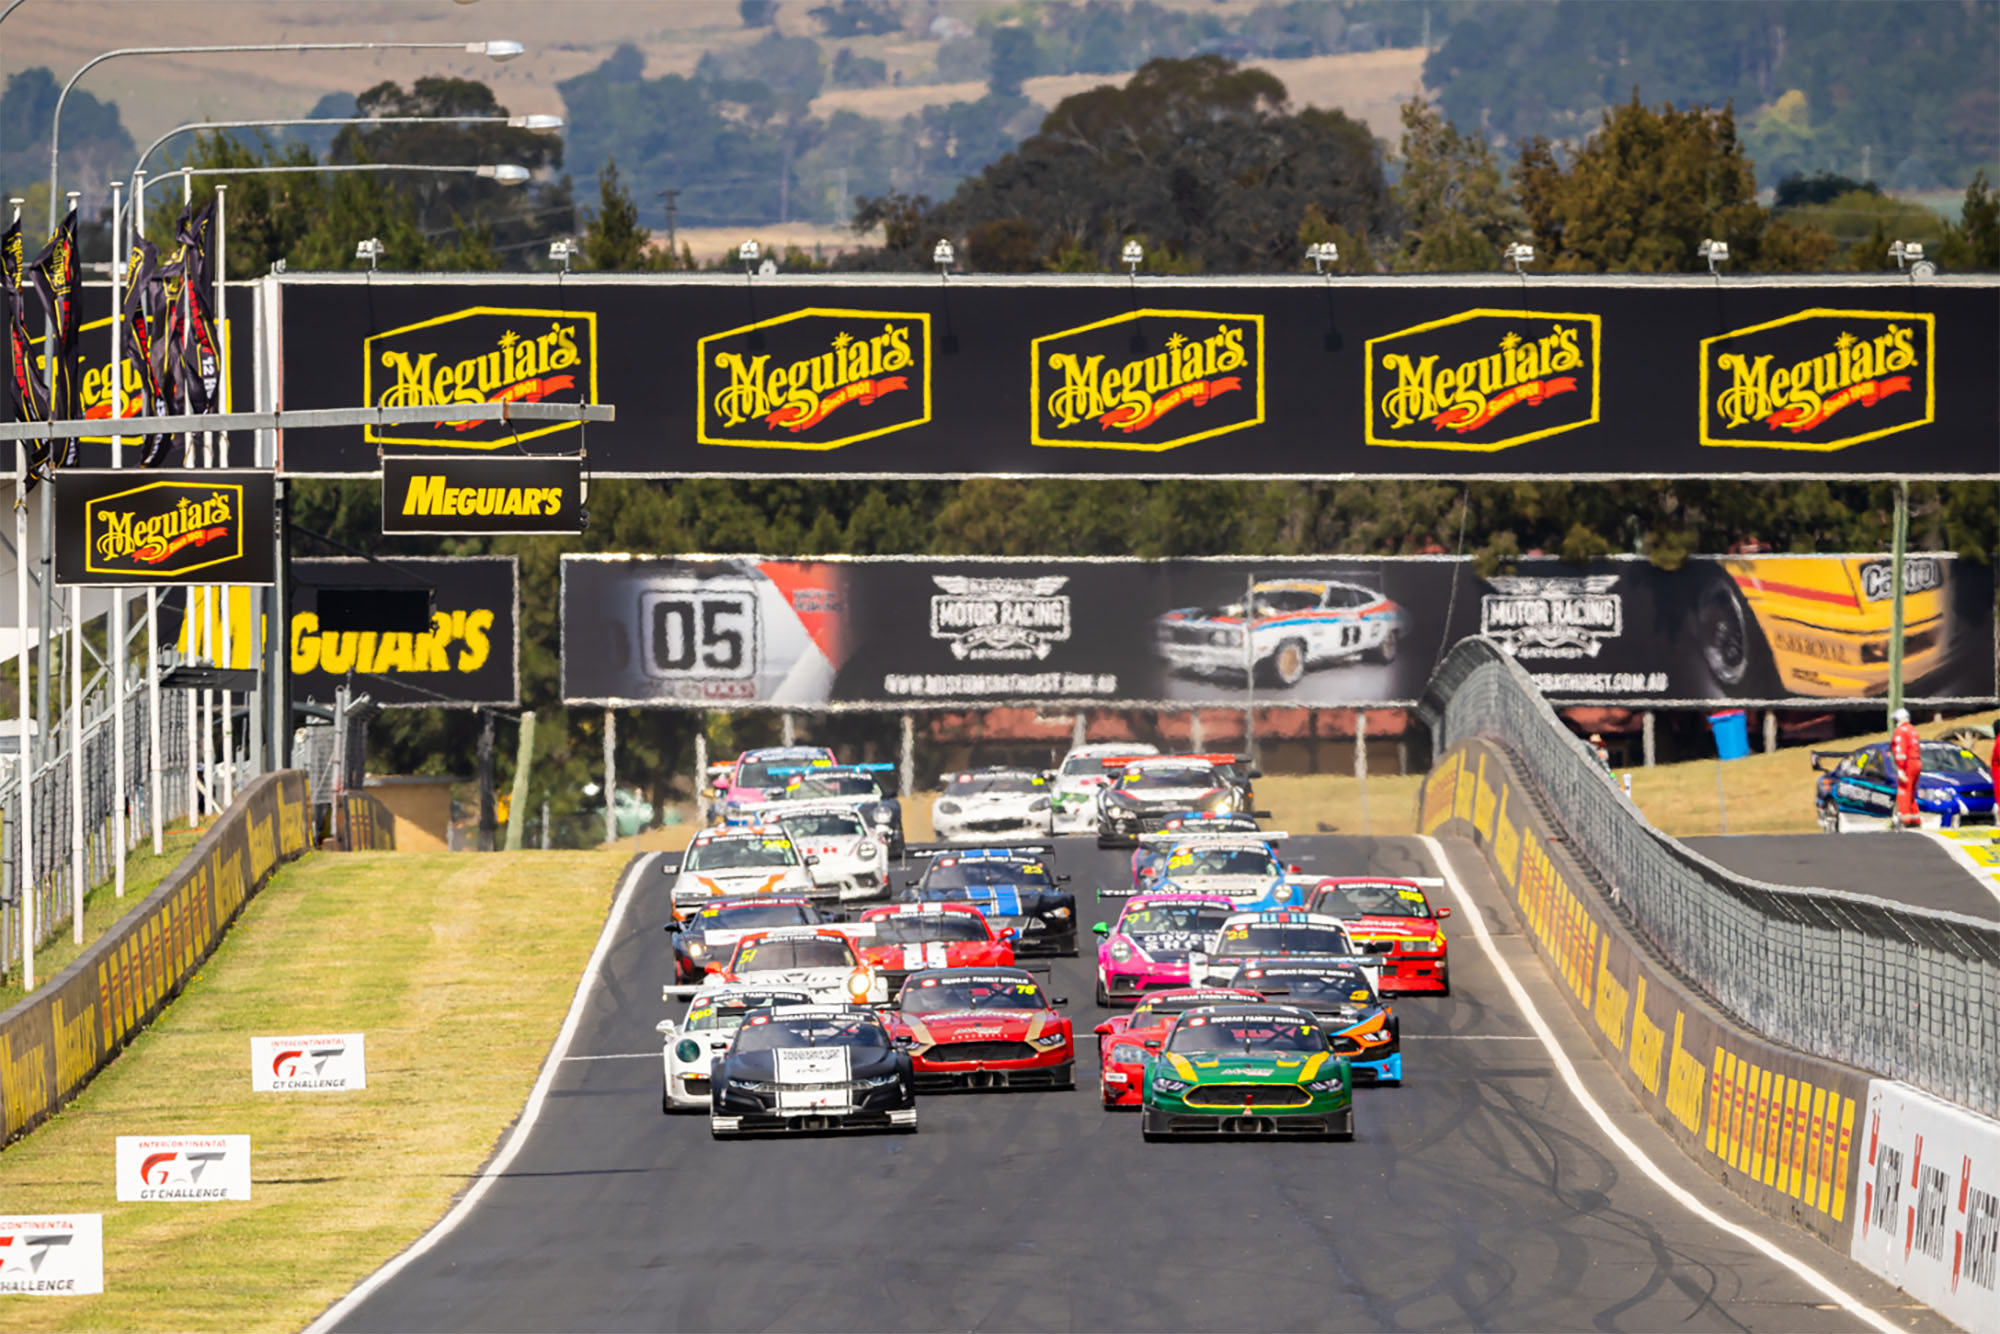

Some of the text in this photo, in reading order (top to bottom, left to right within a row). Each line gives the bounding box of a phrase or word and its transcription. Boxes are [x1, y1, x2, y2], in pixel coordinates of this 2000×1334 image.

[714, 323, 912, 428] Meguiar's
[1048, 324, 1246, 429] Meguiar's
[1382, 324, 1582, 429] Meguiar's
[1717, 324, 1917, 429] Meguiar's
[97, 492, 231, 561] Meguiar's
[1863, 559, 1938, 602] Catrol
[653, 600, 742, 670] 05
[939, 601, 1063, 627] MOTOR RACING
[1490, 600, 1614, 627] MOTOR RACING
[273, 1079, 346, 1090] GT CHALLENGE
[141, 1188, 228, 1200] GT CHALLENGE
[0, 1220, 73, 1231] CONTINENTAL
[0, 1280, 74, 1291] HALLENGE
